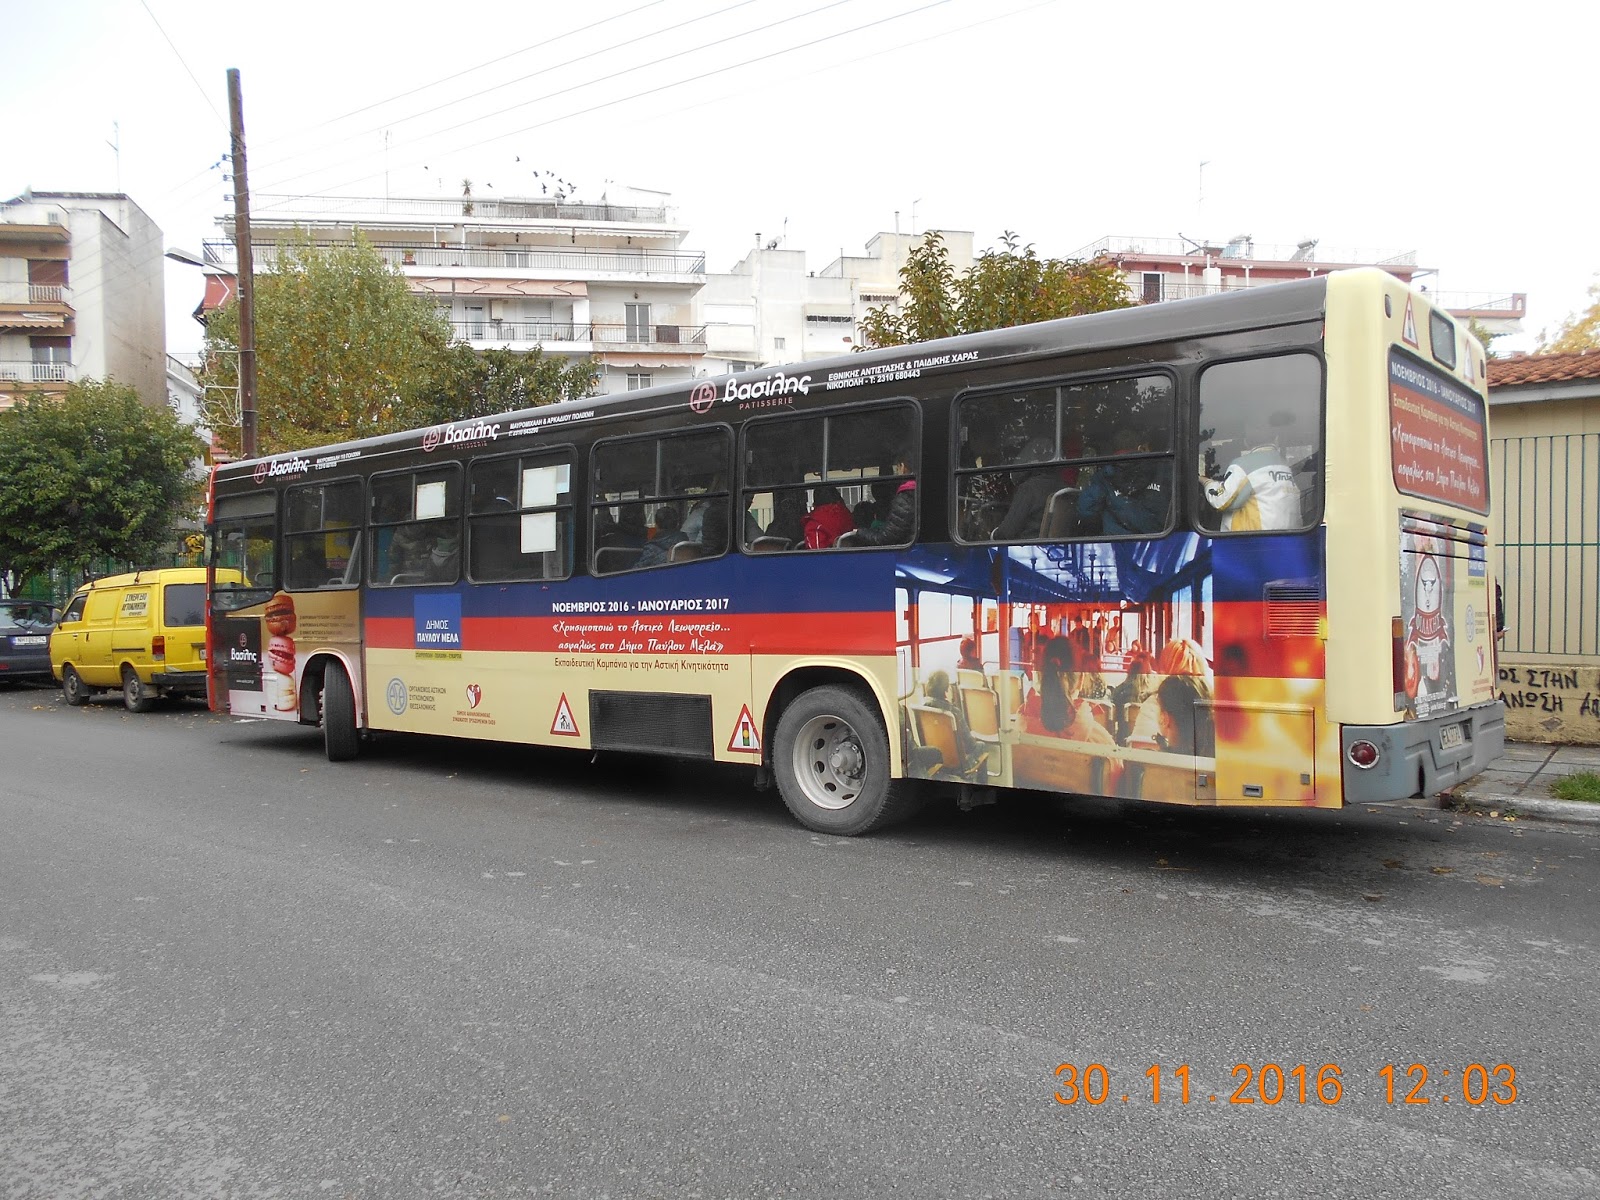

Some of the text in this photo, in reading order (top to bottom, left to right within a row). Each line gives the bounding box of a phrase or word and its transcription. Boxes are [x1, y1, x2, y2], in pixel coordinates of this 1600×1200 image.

[828, 370, 860, 381] ΕΘΝΙΚΗΣ
[860, 362, 905, 376] ΑΝΤΙΣΤΑΣΗΣ
[913, 355, 950, 368] ΠΑΙΔΙΚΗΣ
[951, 351, 979, 363] ΧΑΡΑΣ
[826, 377, 864, 391] ΝΙΚΟΠΟΛΗ
[876, 372, 894, 383] 2310
[895, 369, 921, 380] 680443
[740, 397, 793, 410] PATISSERIE
[552, 601, 606, 612] ΝΟΕΜΒΡΙΟΣ
[608, 601, 629, 612] 2016
[638, 599, 703, 611] ΙΑΝΟΥΑΡΙΟΣ
[705, 598, 729, 610] 2017
[425, 620, 449, 629] ΔΗΜΟΣ
[631, 619, 663, 634] Αστικό
[417, 633, 459, 643] ΠΑΥΛΟΥ ΜΕΛΑ
[558, 639, 596, 653] ασφαλώς
[600, 642, 614, 650] στο
[618, 638, 643, 654] Δήμο
[648, 638, 685, 654] Παύλου
[555, 657, 729, 673] Εκπαιδευτική Καμπάνια για την Αστική Κινητικότητα
[1526, 668, 1578, 689] ΣΤΗΝ
